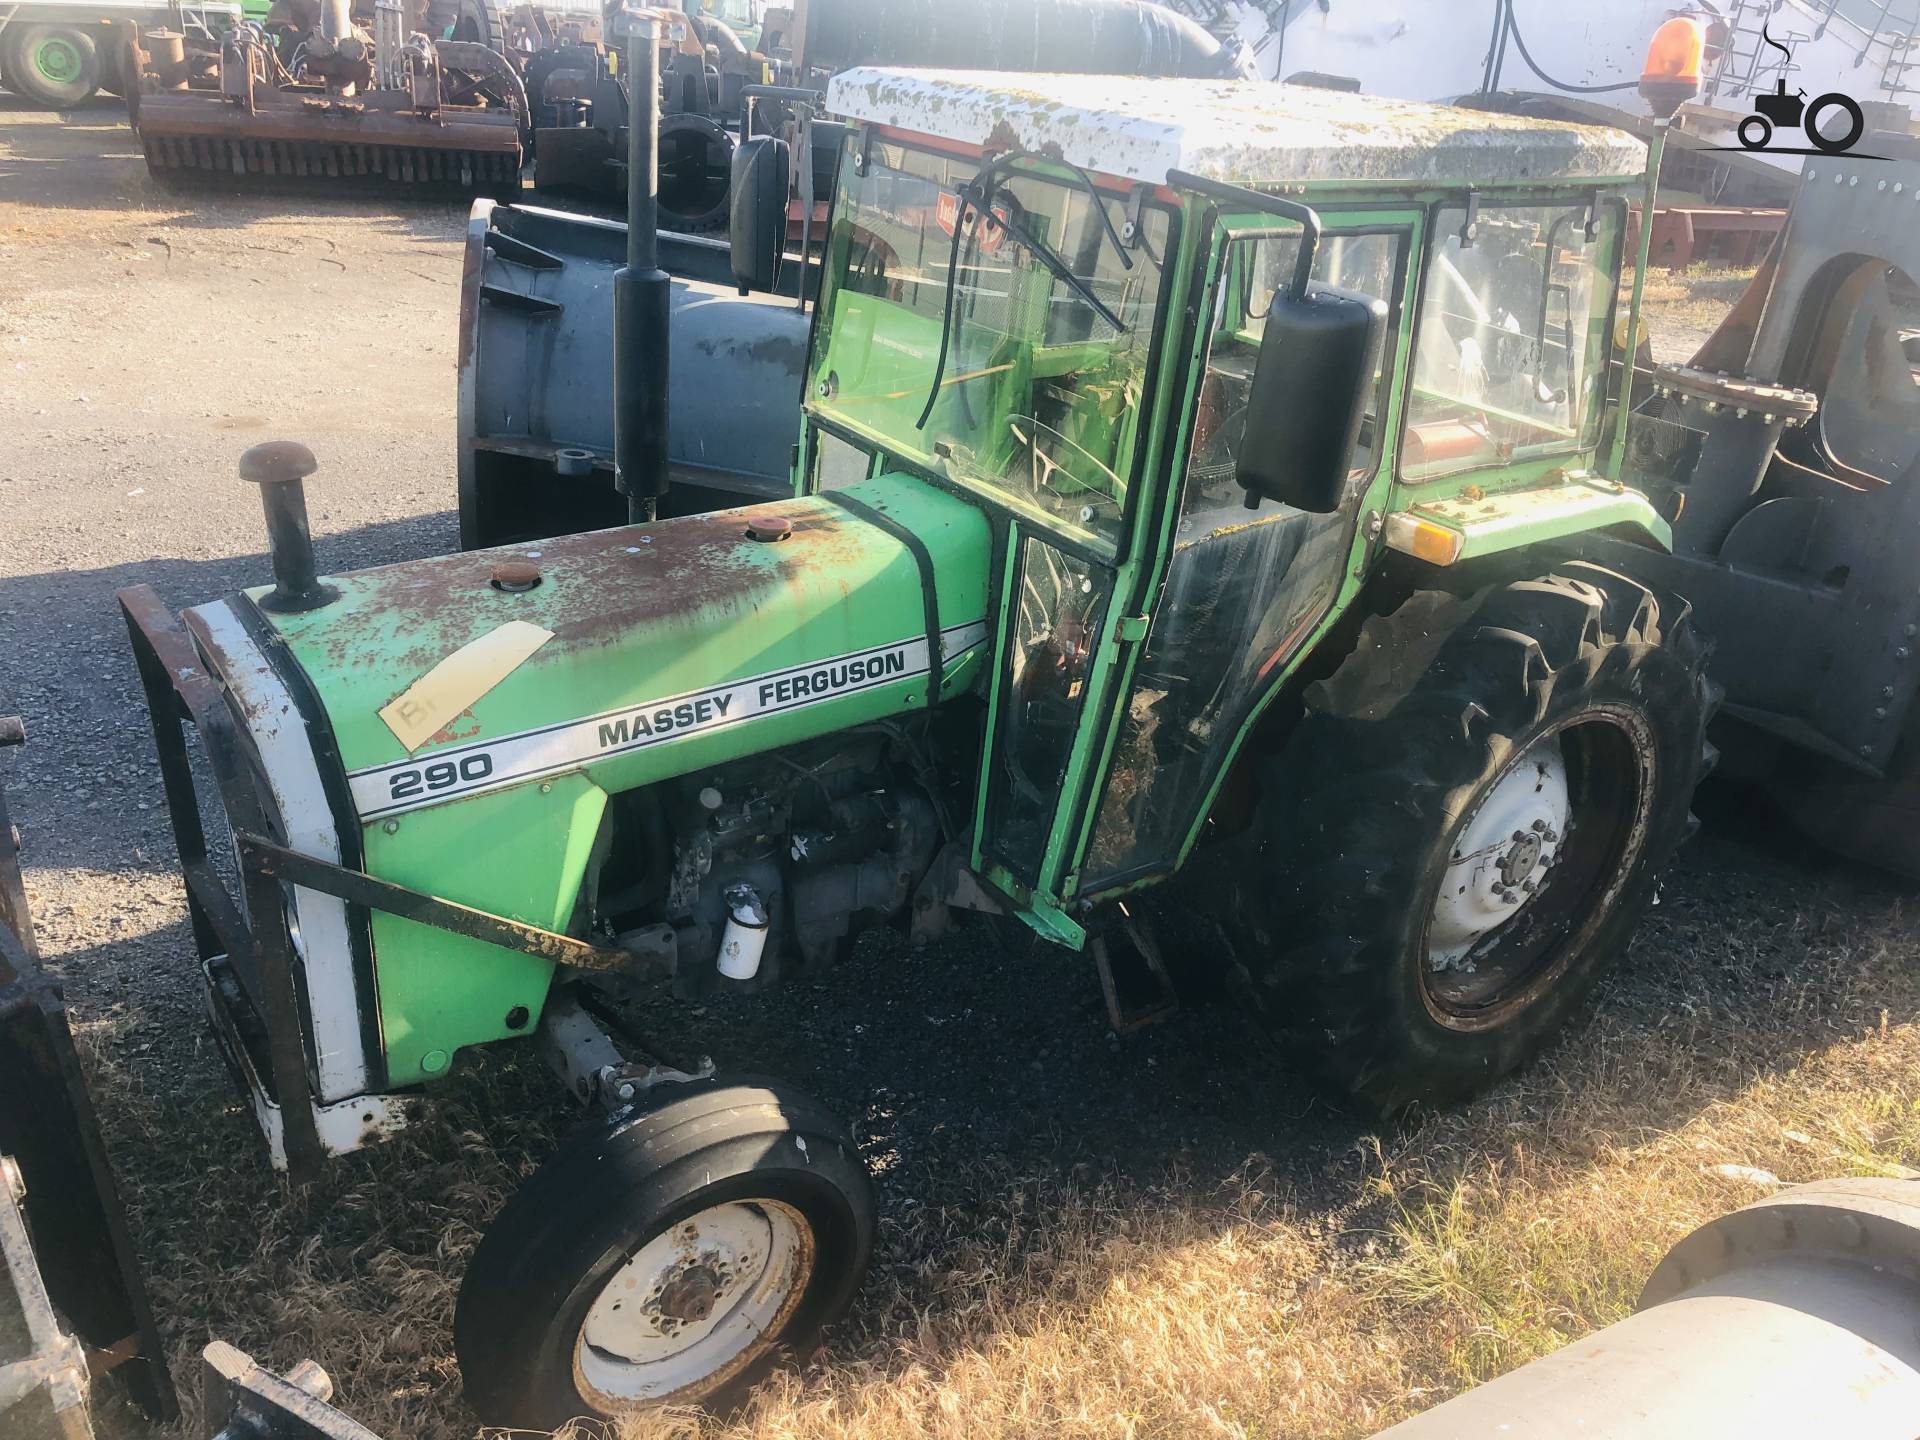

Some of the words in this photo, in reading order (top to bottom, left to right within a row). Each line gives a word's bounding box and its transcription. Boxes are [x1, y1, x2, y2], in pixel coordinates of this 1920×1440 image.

[598, 693, 733, 748] MASSEY
[758, 650, 905, 707] FERGUSON
[389, 753, 493, 800] 290
